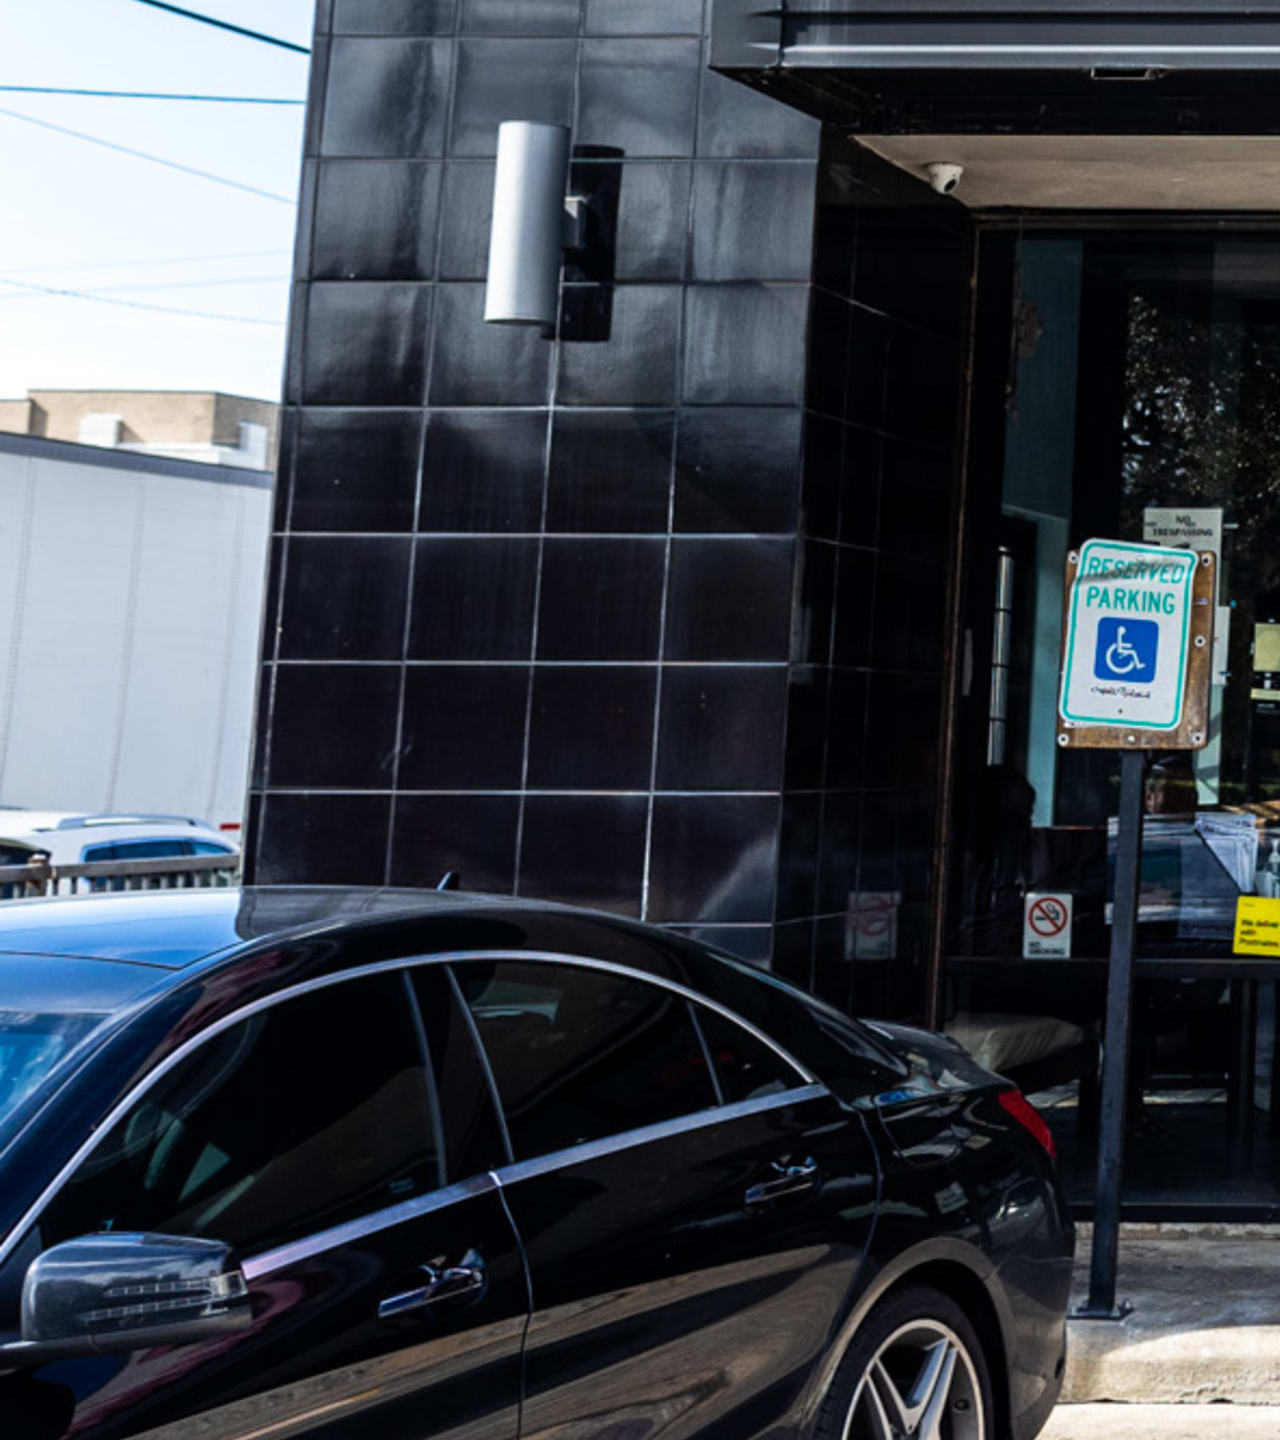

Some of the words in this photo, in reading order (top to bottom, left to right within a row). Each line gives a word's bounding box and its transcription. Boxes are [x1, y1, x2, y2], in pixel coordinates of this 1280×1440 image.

[1152, 528, 1214, 537] TRESPASSING
[1087, 556, 1185, 584] RESERVED
[1086, 586, 1175, 615] PARKING
